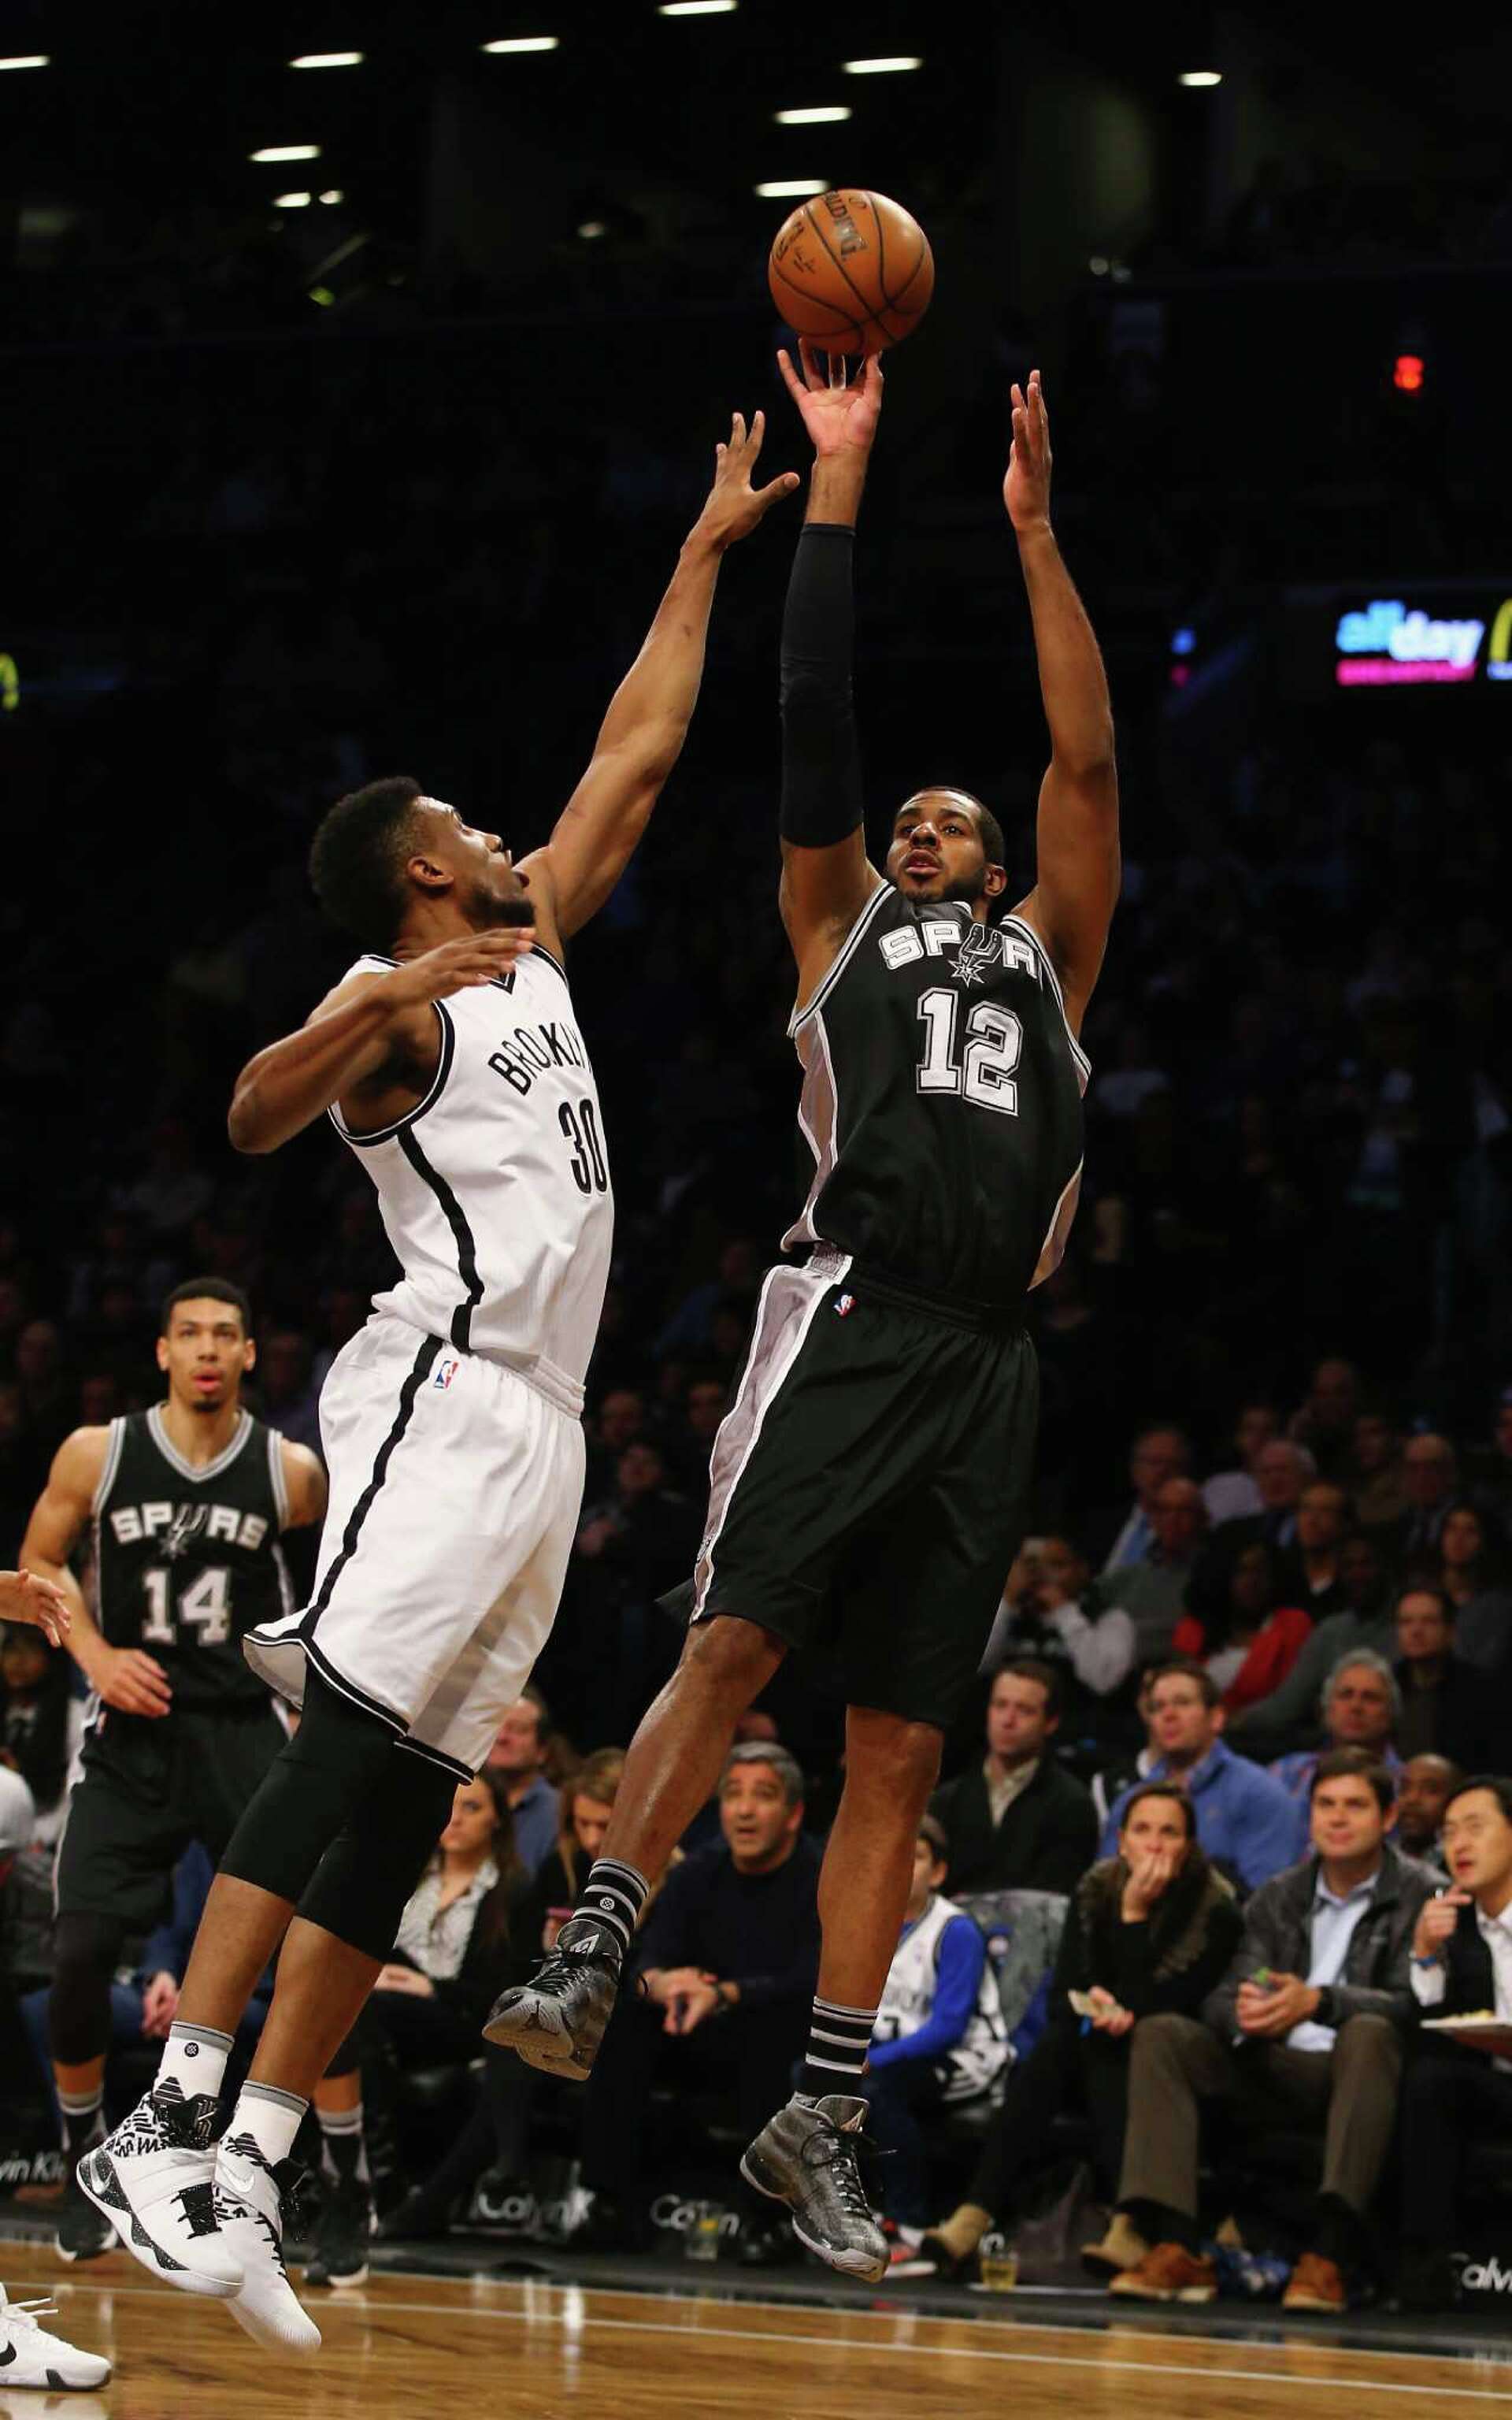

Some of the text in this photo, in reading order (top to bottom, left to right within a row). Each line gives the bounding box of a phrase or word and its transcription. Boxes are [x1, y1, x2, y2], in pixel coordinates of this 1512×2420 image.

[878, 920, 1043, 986] SPUR
[916, 986, 1024, 1116] 12
[558, 1099, 606, 1193] 30
[110, 1500, 269, 1557] SPURS
[142, 1564, 232, 1646] 14
